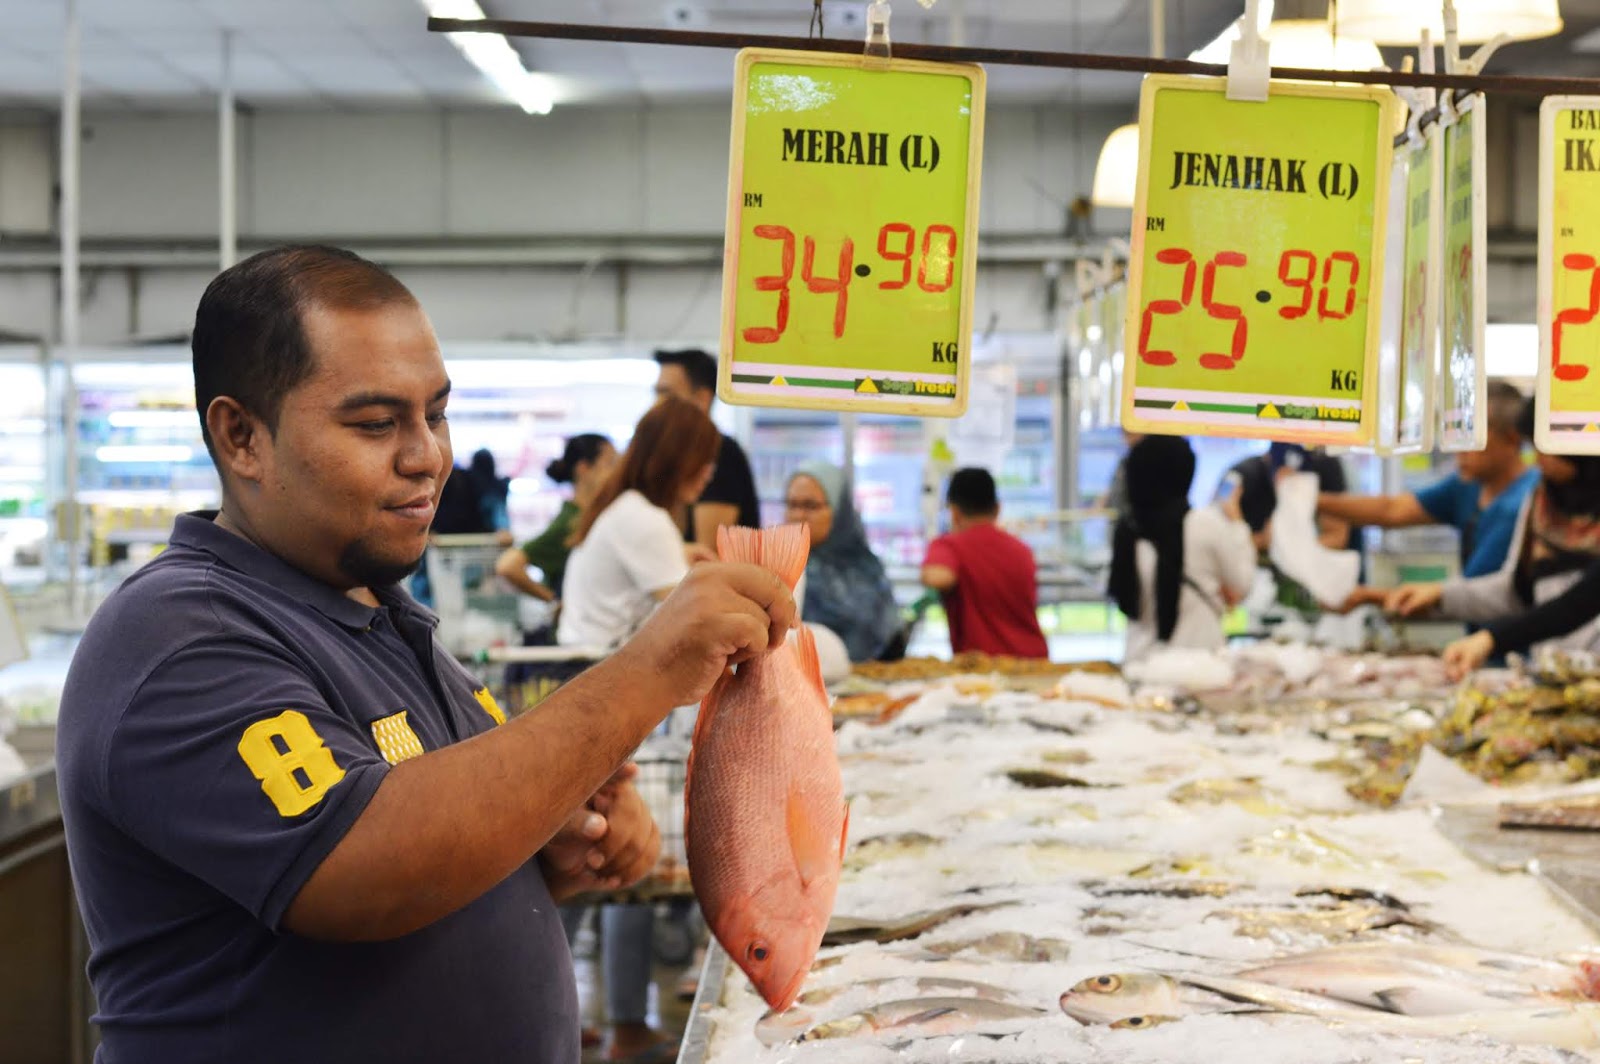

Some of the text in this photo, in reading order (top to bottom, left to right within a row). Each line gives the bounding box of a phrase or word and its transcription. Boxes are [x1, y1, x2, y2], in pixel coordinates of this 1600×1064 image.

[1571, 109, 1600, 130] BA
[782, 128, 940, 173] MERAH (L)
[1564, 138, 1600, 171] IK
[1169, 151, 1359, 200] JENAHAK (L)
[744, 192, 763, 208] RM
[1146, 216, 1165, 232] RM
[931, 341, 958, 364] KG
[1330, 369, 1357, 392] KG
[237, 709, 346, 817] 8
